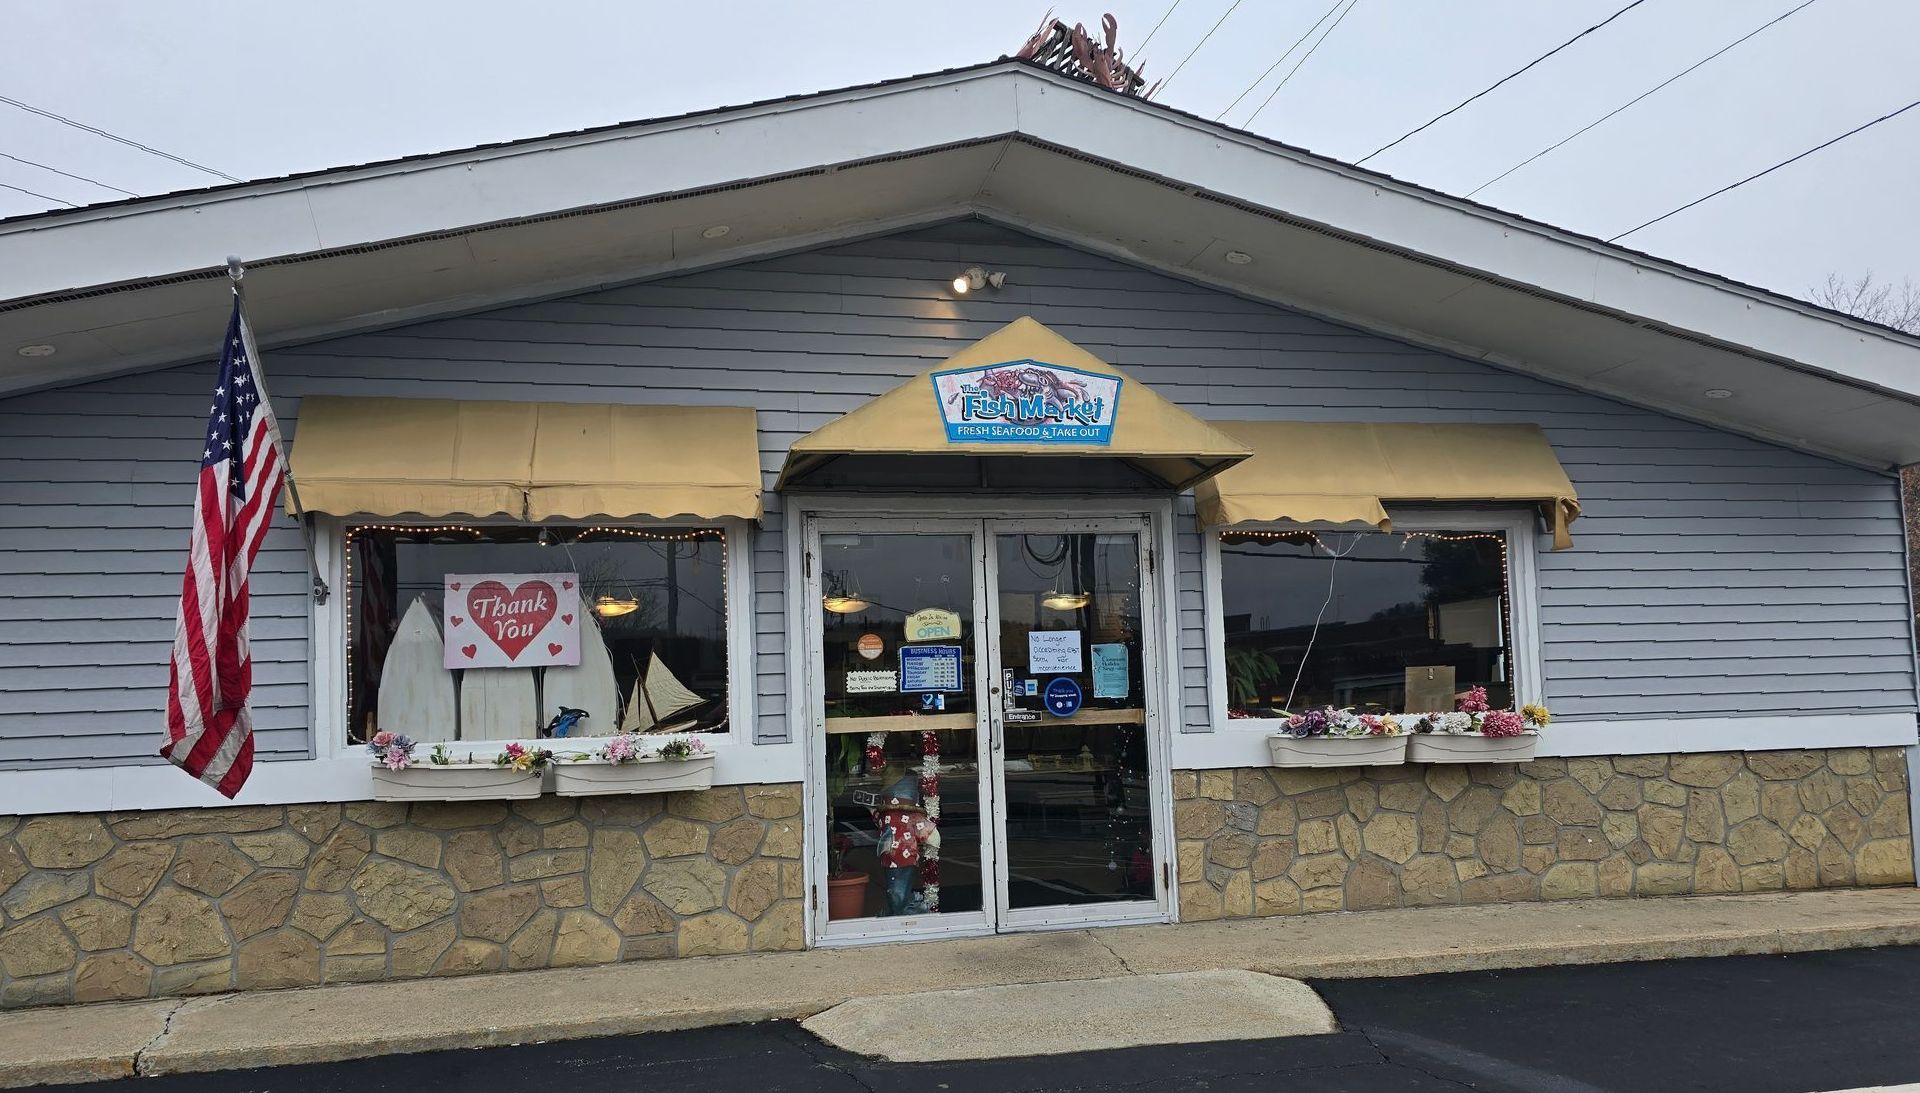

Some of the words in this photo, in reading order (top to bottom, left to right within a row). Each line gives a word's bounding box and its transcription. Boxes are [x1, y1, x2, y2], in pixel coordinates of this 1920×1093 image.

[961, 384, 979, 393] The
[962, 390, 1015, 421] Fish
[1018, 394, 1105, 426] Market
[957, 426, 989, 435] FRESH
[991, 426, 1040, 436] SEAFOOD
[1042, 428, 1050, 437] &
[1052, 428, 1077, 437] TAKE
[1079, 428, 1101, 437] OUT
[473, 590, 548, 619] Thank
[493, 618, 534, 641] You
[917, 626, 950, 639] OPEN
[1031, 635, 1040, 643] No
[1043, 635, 1067, 646] Longer
